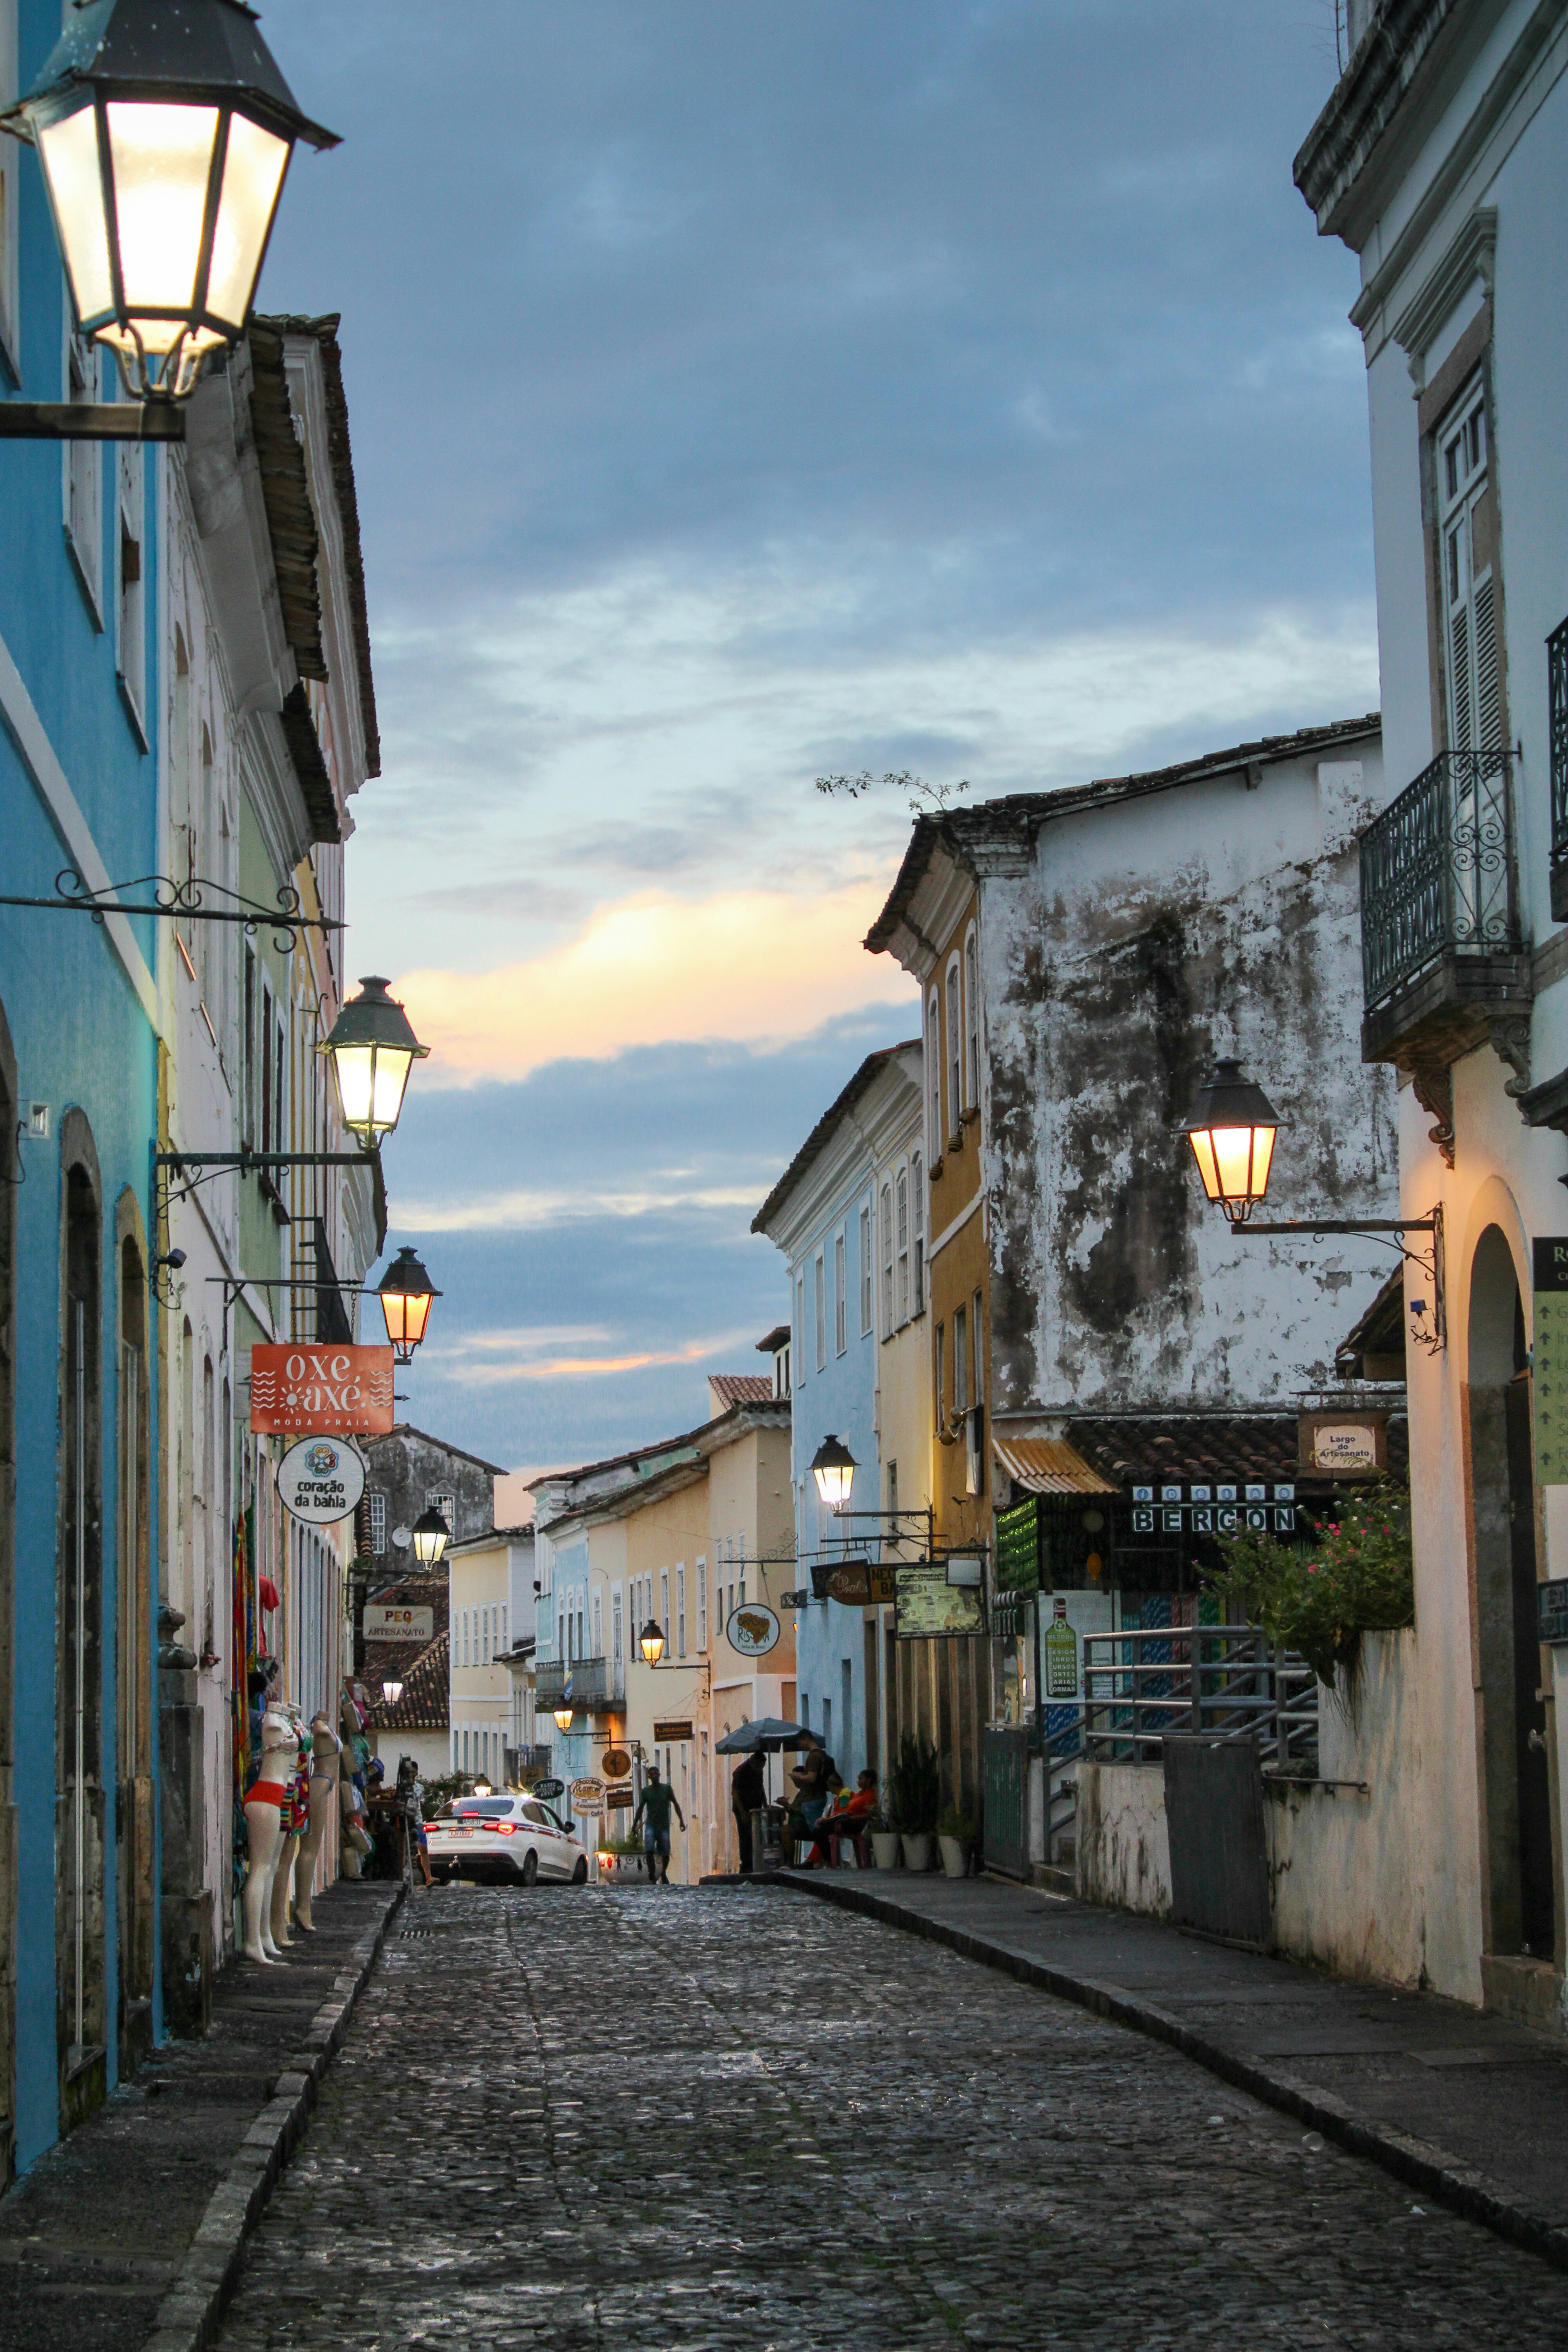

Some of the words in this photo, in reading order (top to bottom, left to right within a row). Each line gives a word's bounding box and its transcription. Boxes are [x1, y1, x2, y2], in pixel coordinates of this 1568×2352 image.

[1554, 1247, 1568, 1262] R
[297, 1480, 345, 1494] coração
[295, 1494, 309, 1506] da
[314, 1494, 346, 1508] bahia
[1138, 1510, 1294, 1530] BERGON
[368, 1628, 425, 1636] ARTESANATO
